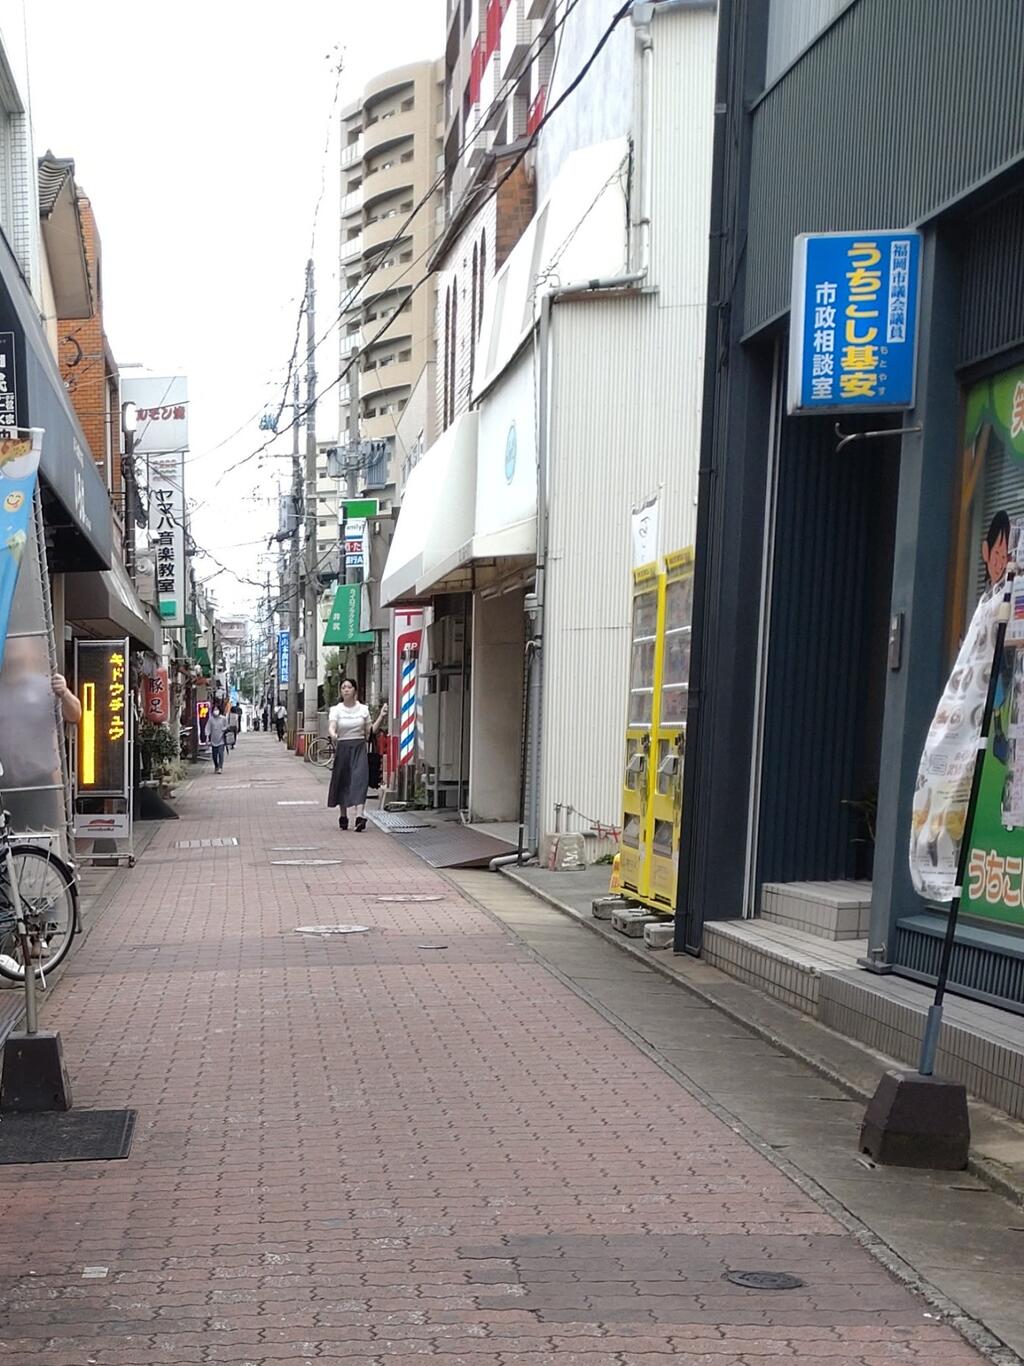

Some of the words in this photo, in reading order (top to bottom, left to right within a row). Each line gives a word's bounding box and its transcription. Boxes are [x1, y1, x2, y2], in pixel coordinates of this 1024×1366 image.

[811, 281, 837, 400] 市政相談室
[840, 241, 881, 398] うちこし基安
[888, 242, 909, 340] 福岡市議会議員
[135, 405, 186, 421] ルモン焼
[156, 488, 176, 593] ヤマハ音楽教室
[109, 652, 125, 741] キドウチュウ
